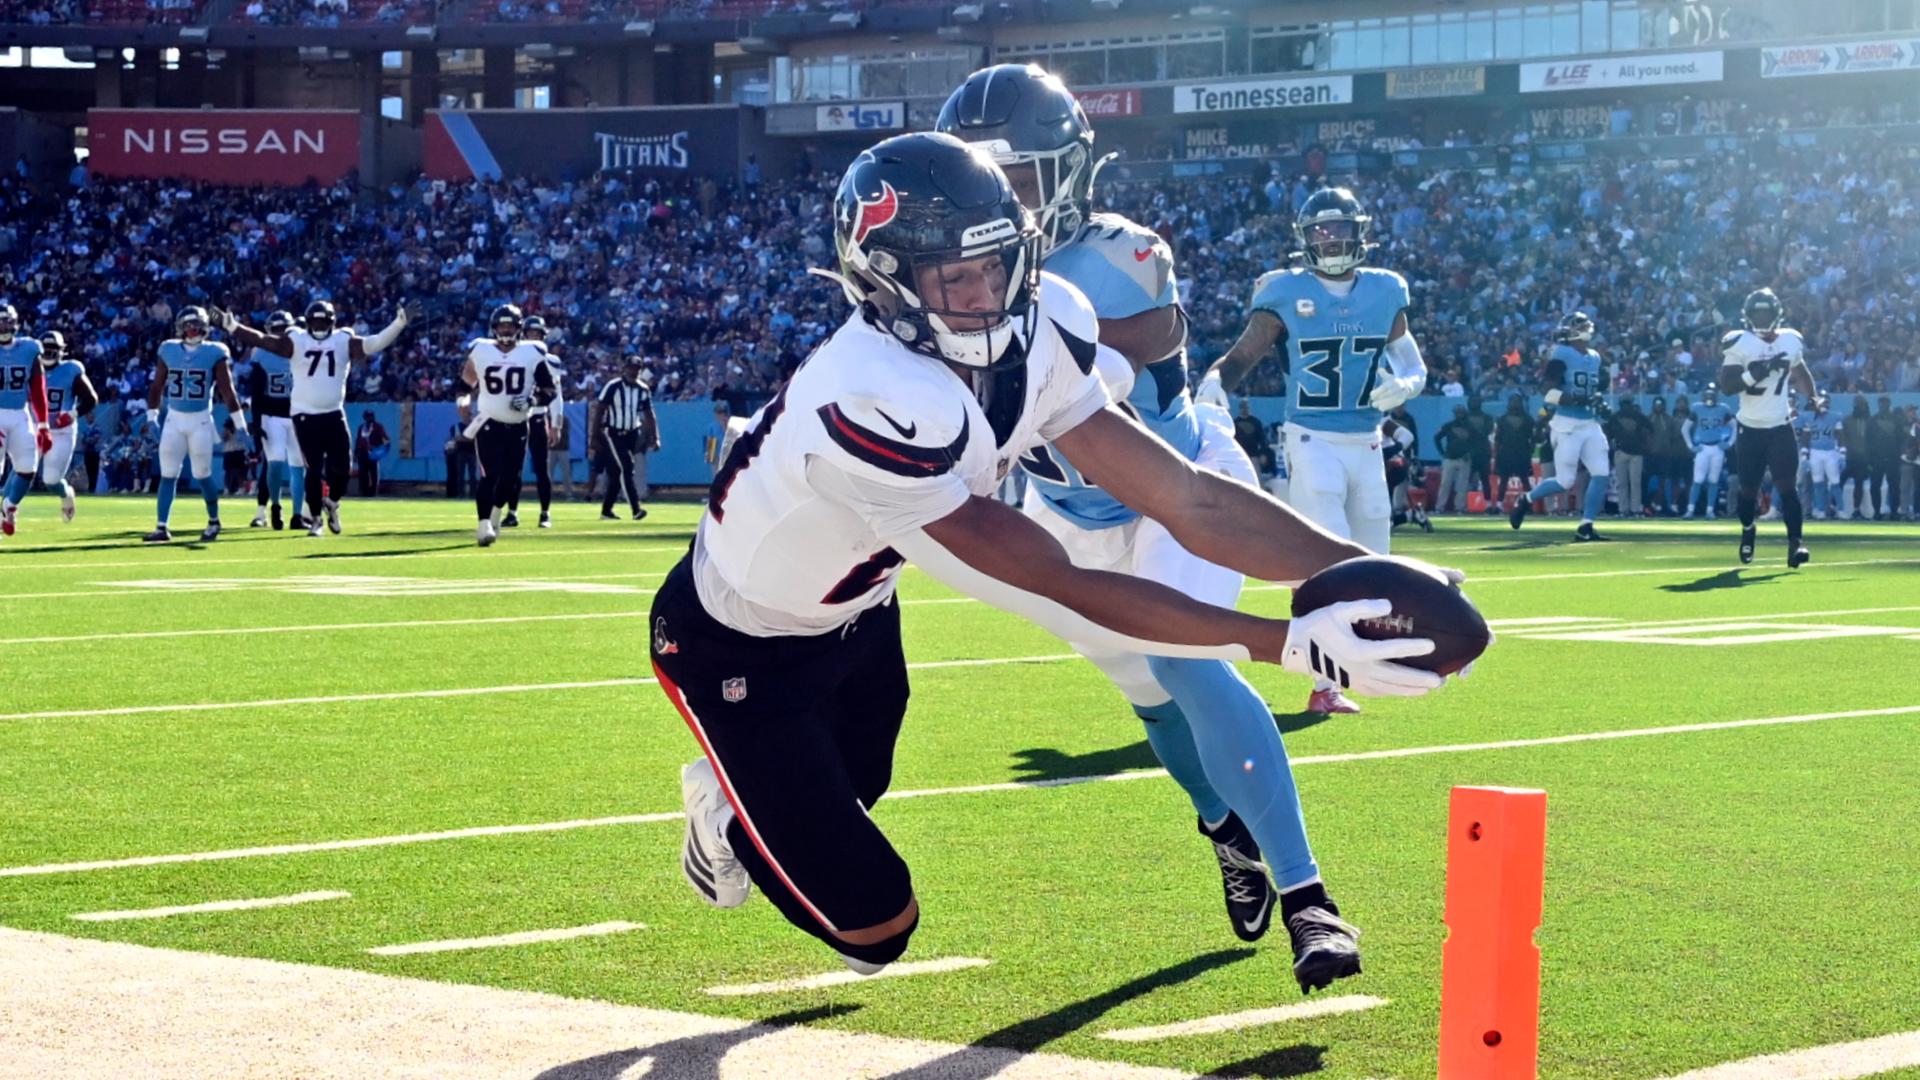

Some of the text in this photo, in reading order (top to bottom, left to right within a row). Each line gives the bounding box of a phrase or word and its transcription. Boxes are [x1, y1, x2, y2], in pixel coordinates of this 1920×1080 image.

[1561, 64, 1592, 79] LEE
[1618, 66, 1635, 79] All
[1638, 66, 1661, 80] you
[1664, 61, 1698, 76] need.
[1191, 84, 1339, 110] Tennessean.
[847, 105, 893, 128] tsu
[124, 128, 324, 154] NISSAN
[1186, 128, 1228, 146] MIKE
[594, 131, 688, 171] TITANS
[1186, 143, 1270, 160] MUCHA
[304, 350, 336, 377] 71
[1296, 336, 1387, 409] 37
[0, 366, 26, 391] 8
[168, 368, 208, 399] 33
[268, 372, 293, 397] 5
[484, 366, 526, 395] 60
